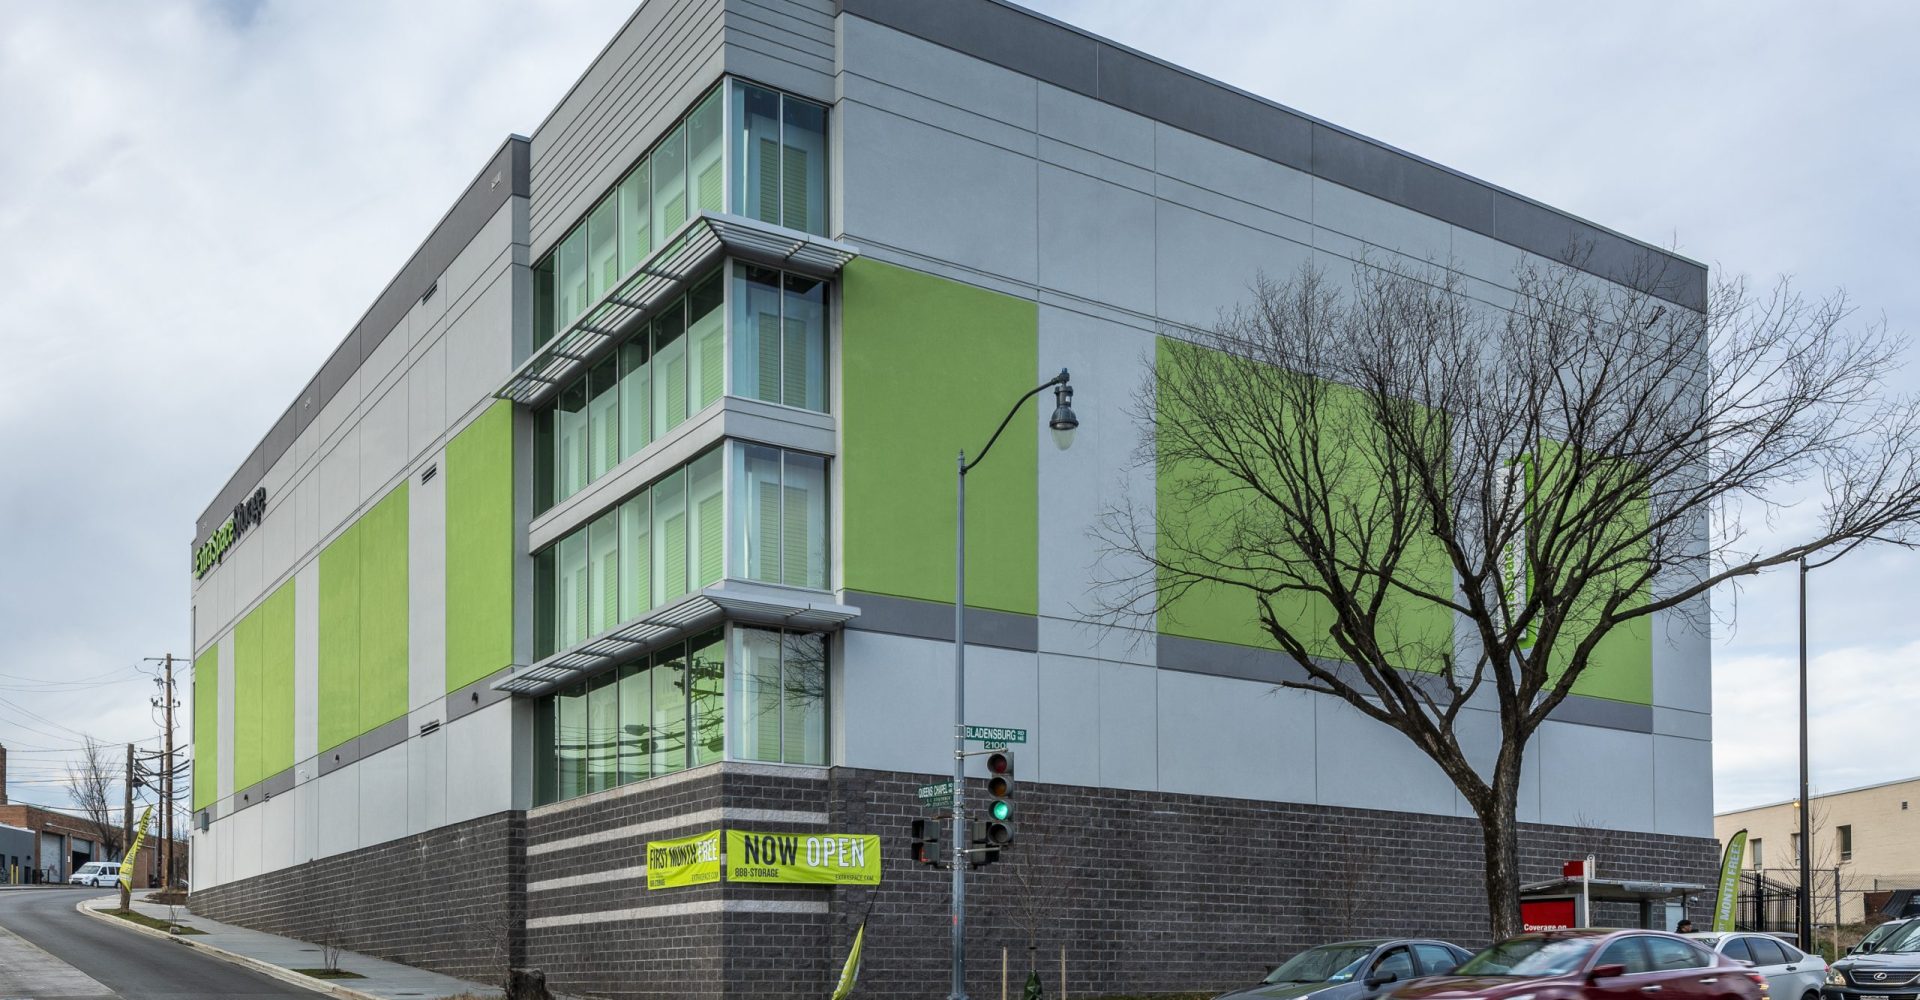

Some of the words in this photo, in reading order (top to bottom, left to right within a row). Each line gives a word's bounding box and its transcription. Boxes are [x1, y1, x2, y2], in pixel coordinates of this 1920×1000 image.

[966, 727, 1016, 740] BLADENSBURG
[985, 741, 1006, 749] 2100
[650, 847, 668, 870] FIRST
[669, 843, 697, 868] MONTH
[697, 838, 718, 863] FREE
[744, 834, 798, 866] NOW
[806, 836, 866, 868] OPEN
[734, 867, 780, 878] 888-STORAGE
[1720, 878, 1734, 920] MONTH
[1523, 923, 1557, 933] Coverage
